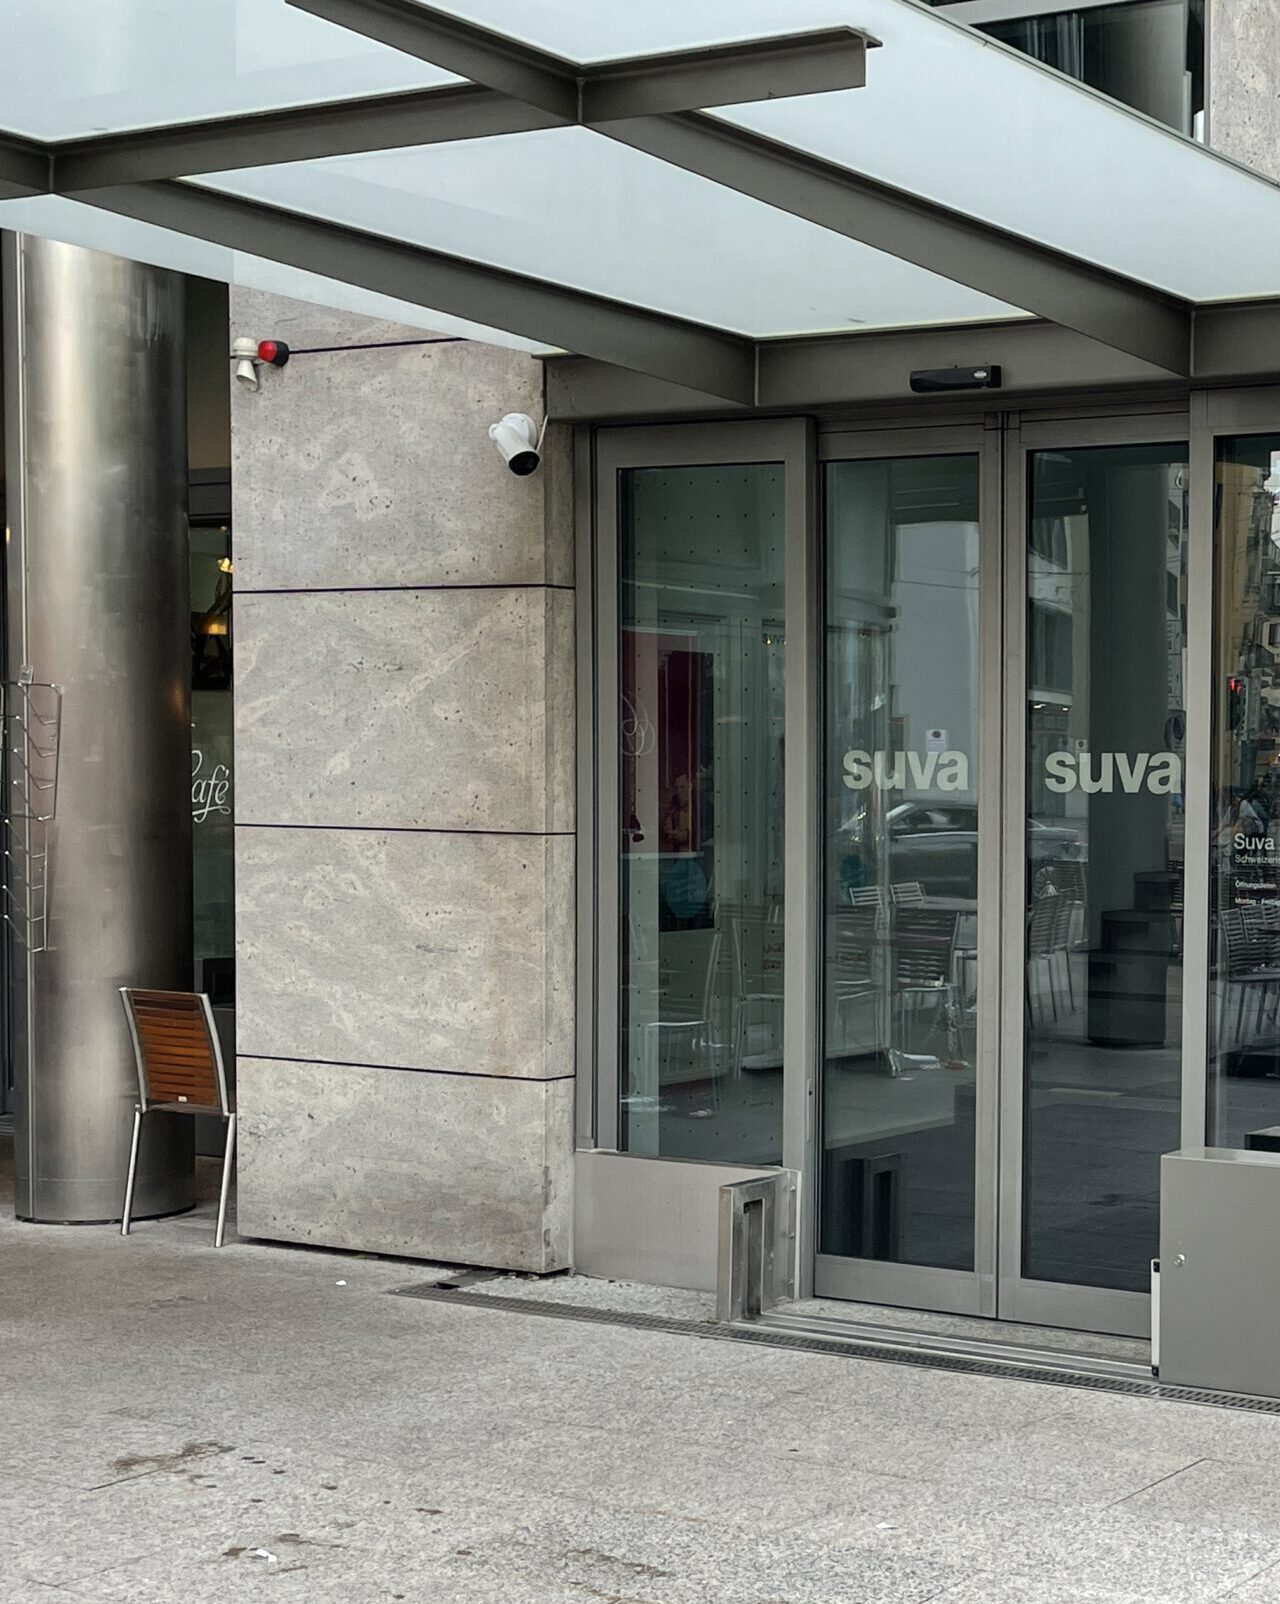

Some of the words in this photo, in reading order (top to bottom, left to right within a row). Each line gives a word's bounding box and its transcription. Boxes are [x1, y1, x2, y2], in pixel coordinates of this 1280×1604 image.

[843, 749, 969, 791] suva
[1045, 751, 1182, 795] suva
[1234, 833, 1275, 850] Suva
